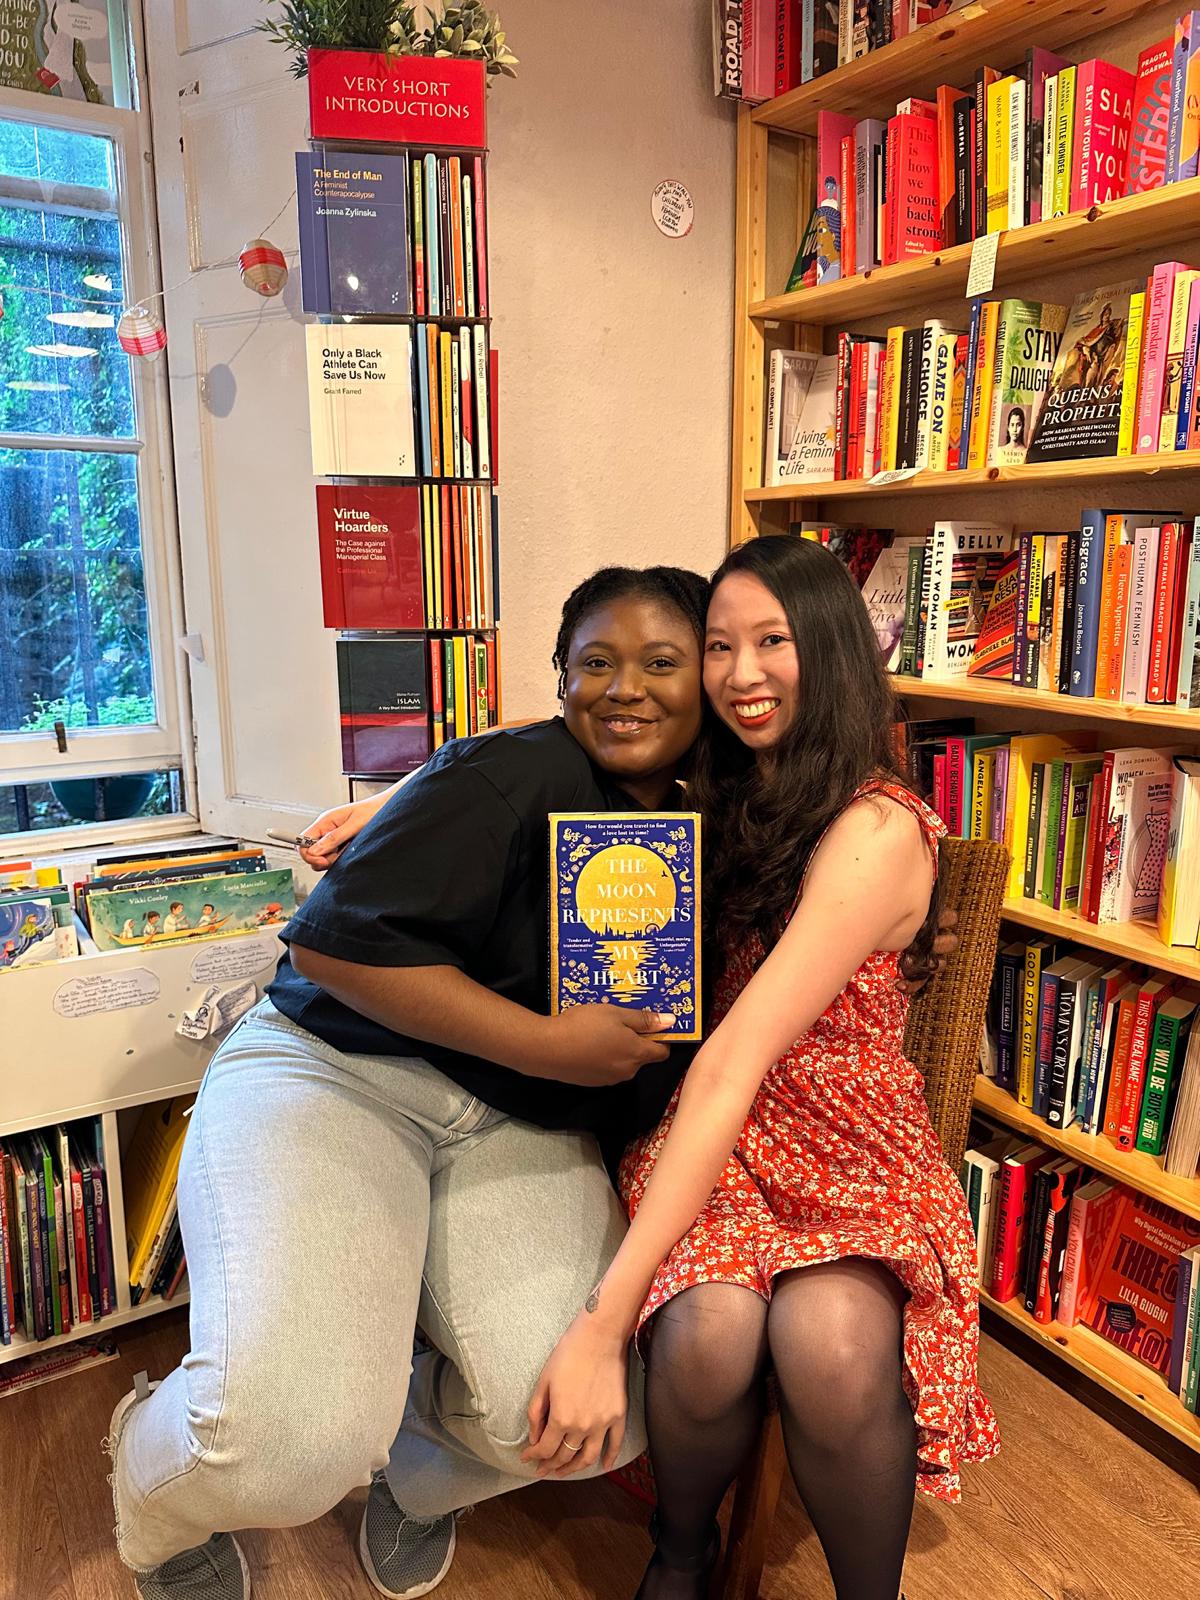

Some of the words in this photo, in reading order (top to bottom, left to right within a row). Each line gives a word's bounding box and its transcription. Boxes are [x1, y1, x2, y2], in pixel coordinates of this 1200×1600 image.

[16, 34, 28, 49] TO
[726, 19, 739, 86] ROAD
[777, 25, 785, 71] POWER
[1140, 58, 1173, 78] AGARWAL
[1141, 50, 1168, 68] PRAGYA
[344, 76, 388, 92] VERY
[393, 79, 450, 96] SHORT
[1085, 85, 1094, 111] SLAY
[326, 96, 470, 118] INTRODUCTIONS
[1058, 115, 1068, 140] LITTLE
[1084, 113, 1092, 127] IN
[908, 126, 933, 143] This
[1082, 129, 1091, 159] YOUR
[1111, 125, 1128, 151] IN
[908, 144, 918, 156] is
[1057, 142, 1065, 174] WONDER
[314, 169, 332, 178] The
[334, 170, 350, 180] End
[352, 171, 362, 180] of
[364, 172, 382, 181] Man
[908, 159, 932, 173] how
[1080, 161, 1089, 190] LANE
[314, 189, 374, 198] Counterapocalypse
[321, 181, 348, 189] Feminist
[908, 179, 923, 189] we
[316, 207, 344, 216] Joanna
[345, 208, 376, 217] Zylinska
[907, 195, 938, 208] come
[907, 205, 935, 223] back
[1153, 273, 1167, 309] Tinder
[980, 307, 988, 336] RAISING
[1128, 300, 1143, 333] The
[922, 326, 933, 350] NO
[1023, 327, 1063, 363] STAY
[1148, 310, 1163, 361] Translator
[322, 349, 344, 359] Only
[347, 350, 353, 358] a
[355, 349, 382, 358] Black
[322, 360, 356, 369] Athlete
[359, 360, 377, 368] Can
[978, 339, 986, 369] BOYS
[1124, 336, 1139, 371] Shift
[324, 371, 346, 379] Save
[349, 371, 362, 379] Us
[364, 372, 386, 380] Now
[935, 344, 948, 401] GAME
[918, 360, 931, 421] CHOICE
[973, 385, 982, 418] BETTER
[1048, 384, 1112, 408] QUEENS
[932, 405, 944, 434] ON
[1056, 426, 1076, 434] ARABIAN
[1076, 423, 1116, 432] NOBLEWOMEN
[795, 431, 827, 445] Living
[1041, 441, 1075, 450] CHRISTIANITY
[1070, 432, 1090, 440] SHAPED
[790, 450, 796, 460] a
[786, 463, 805, 475] Life
[334, 508, 370, 519] Virtue
[335, 521, 389, 533] Hoarders
[1109, 519, 1118, 541] Peter
[364, 540, 385, 548] against
[934, 531, 945, 576] BELLY
[958, 535, 1004, 549] BELLY
[1079, 526, 1094, 585] Disgrace
[1107, 543, 1116, 572] Boylan
[1136, 538, 1147, 596] POSTHUMAN
[1067, 538, 1076, 609] ANARCHAFEMINISM
[1161, 561, 1169, 590] FEMALE
[869, 588, 906, 604] Little
[1115, 573, 1127, 601] Fierce
[930, 582, 941, 630] WOMAN
[1077, 603, 1085, 629] Joanna
[1157, 591, 1166, 634] CHARACTER
[1113, 602, 1125, 647] Appetites
[1132, 601, 1142, 646] FEMINISM
[1075, 630, 1083, 655] Bourke
[951, 745, 960, 768] BADLY
[950, 770, 959, 803] BEHAVED
[976, 758, 985, 798] ANGELA
[976, 800, 982, 808] Y.
[949, 805, 958, 834] WOMEN
[605, 859, 648, 874] THE
[596, 884, 657, 899] MOON
[562, 907, 692, 923] REPRESENTS
[612, 946, 641, 961] MY
[593, 970, 661, 986] HEART
[1026, 952, 1036, 987] GOOD
[1025, 992, 1034, 1016] FOR
[1138, 999, 1150, 1017] THIS
[1024, 1020, 1031, 1028] A
[1056, 992, 1072, 1045] WOMEN'S
[1137, 1018, 1148, 1026] IS
[1133, 1027, 1145, 1040] MY
[1159, 1018, 1173, 1047] BOYS
[1023, 1032, 1031, 1059] GIRL
[1131, 1039, 1144, 1059] REAL
[1051, 1047, 1067, 1089] CIRCLE
[1128, 1060, 1140, 1082] NAME
[1152, 1048, 1170, 1073] WILL
[1150, 1075, 1167, 1090] BE
[1146, 1091, 1163, 1119] BOYS
[1141, 1118, 1154, 1139] FORD
[1000, 1169, 1011, 1204] REBEL
[1072, 1208, 1081, 1226] LIFT
[996, 1209, 1007, 1254] BODIES
[1069, 1237, 1078, 1255] YOU
[1065, 1257, 1075, 1283] CLIMB
[1118, 1286, 1138, 1307] LILIA
[1139, 1296, 1169, 1325] GIUGNI
